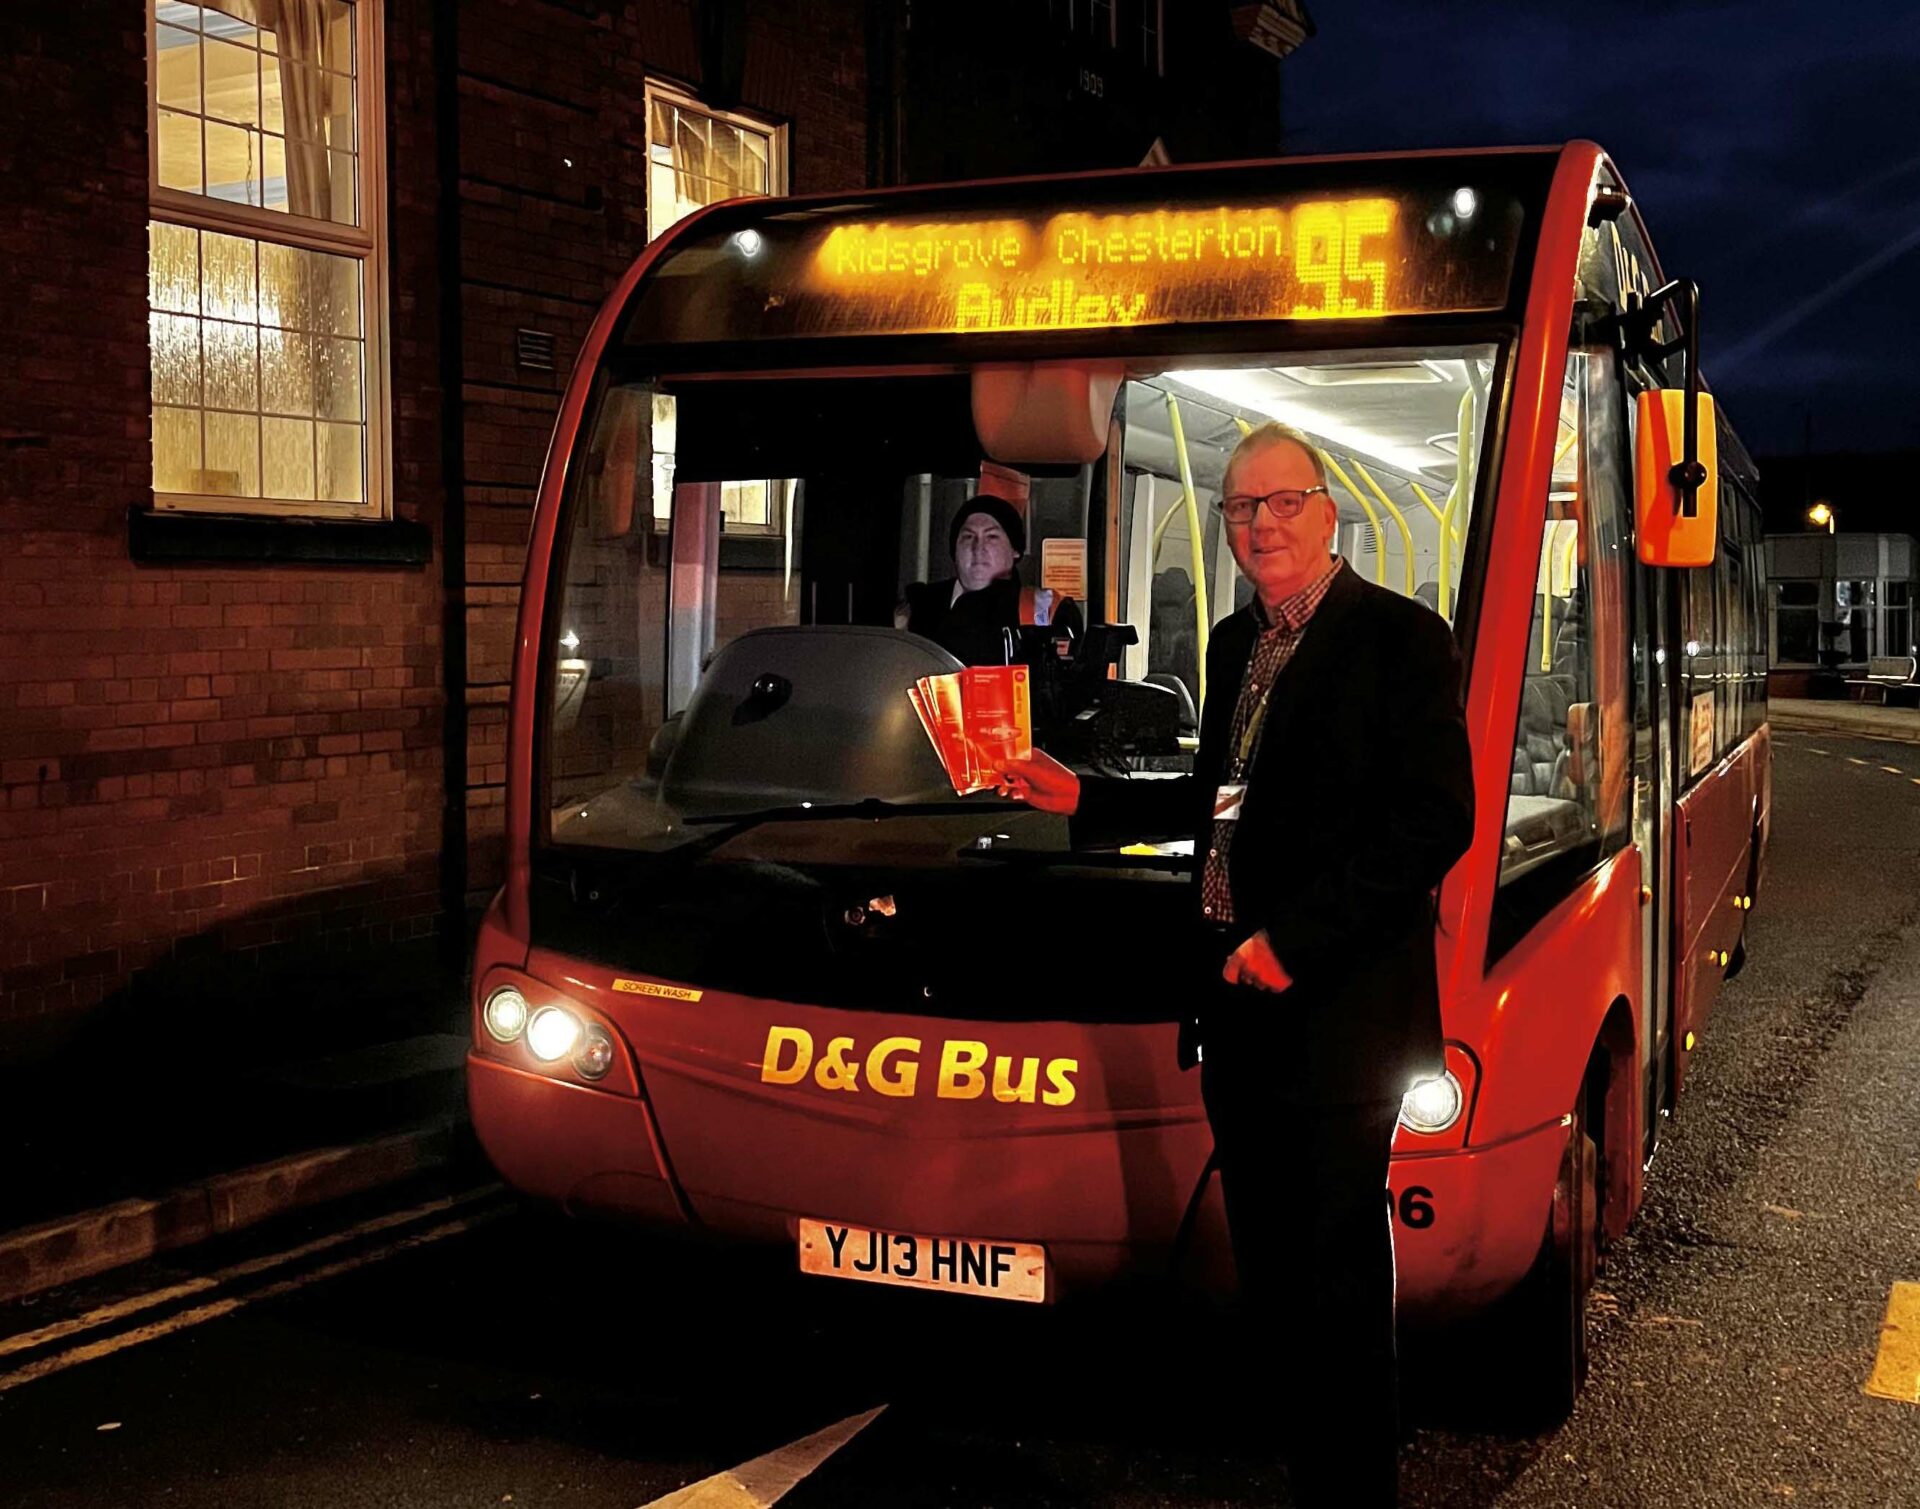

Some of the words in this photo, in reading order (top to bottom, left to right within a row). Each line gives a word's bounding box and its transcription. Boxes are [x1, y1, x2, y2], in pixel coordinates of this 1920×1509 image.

[837, 234, 1021, 277] Kidsgrove
[1058, 222, 1283, 265] Chesterton
[1293, 213, 1389, 319] 95
[623, 982, 662, 994] SCREEN
[663, 988, 691, 999] WASH
[762, 1026, 921, 1097] D&G
[937, 1040, 1078, 1106] Bus
[1386, 1185, 1435, 1229] 6
[825, 1226, 917, 1277] YJ13
[931, 1239, 1016, 1288] HNF
